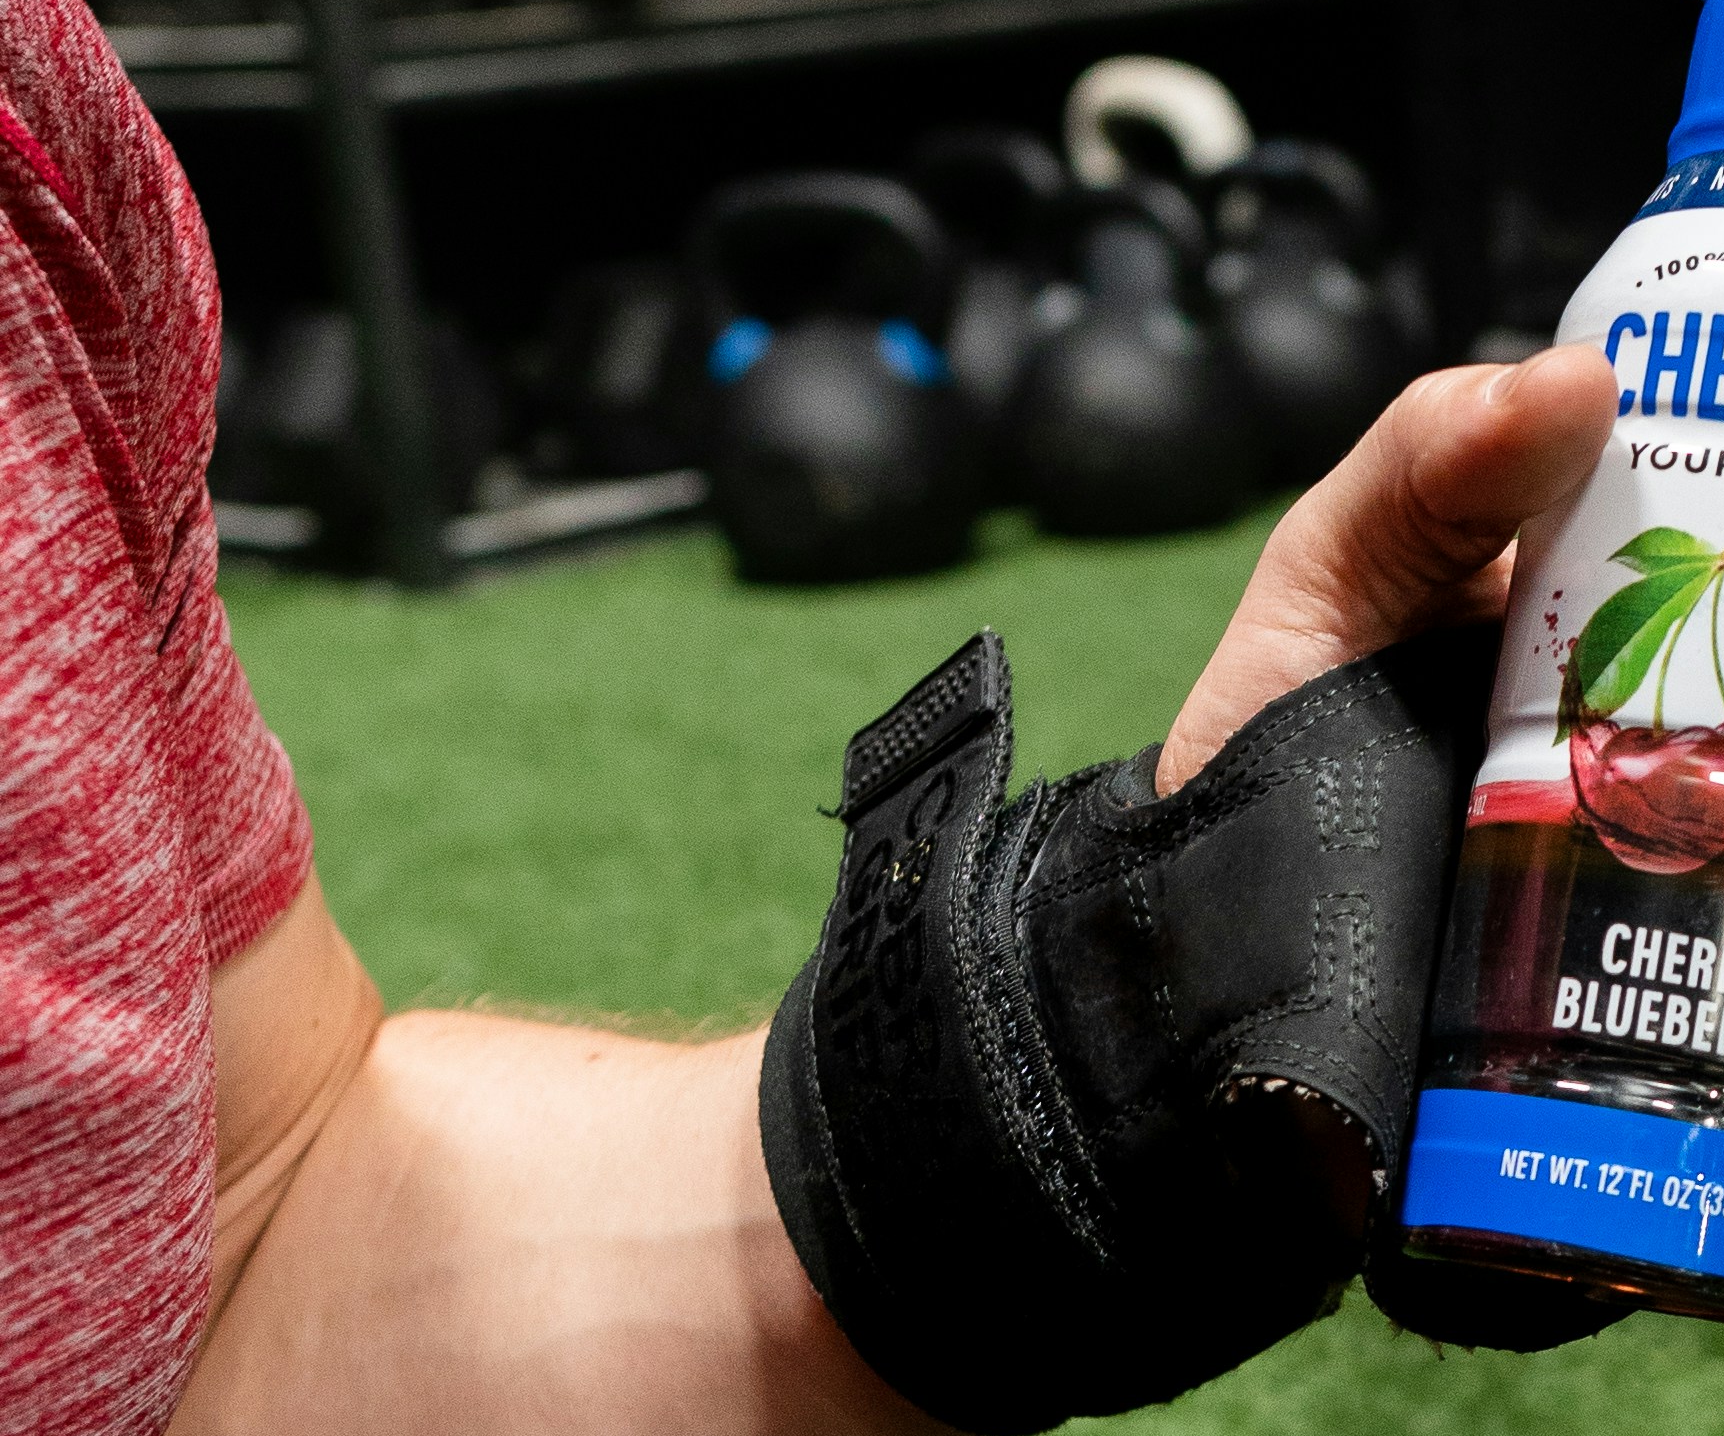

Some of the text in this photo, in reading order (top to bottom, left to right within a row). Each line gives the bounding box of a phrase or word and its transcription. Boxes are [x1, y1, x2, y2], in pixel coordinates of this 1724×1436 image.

[1500, 1148, 1545, 1180] NET
[1550, 1154, 1589, 1189] WT.
[1598, 1163, 1624, 1196] 12
[1628, 1169, 1654, 1202] FL
[1662, 1175, 1696, 1210] OZ
